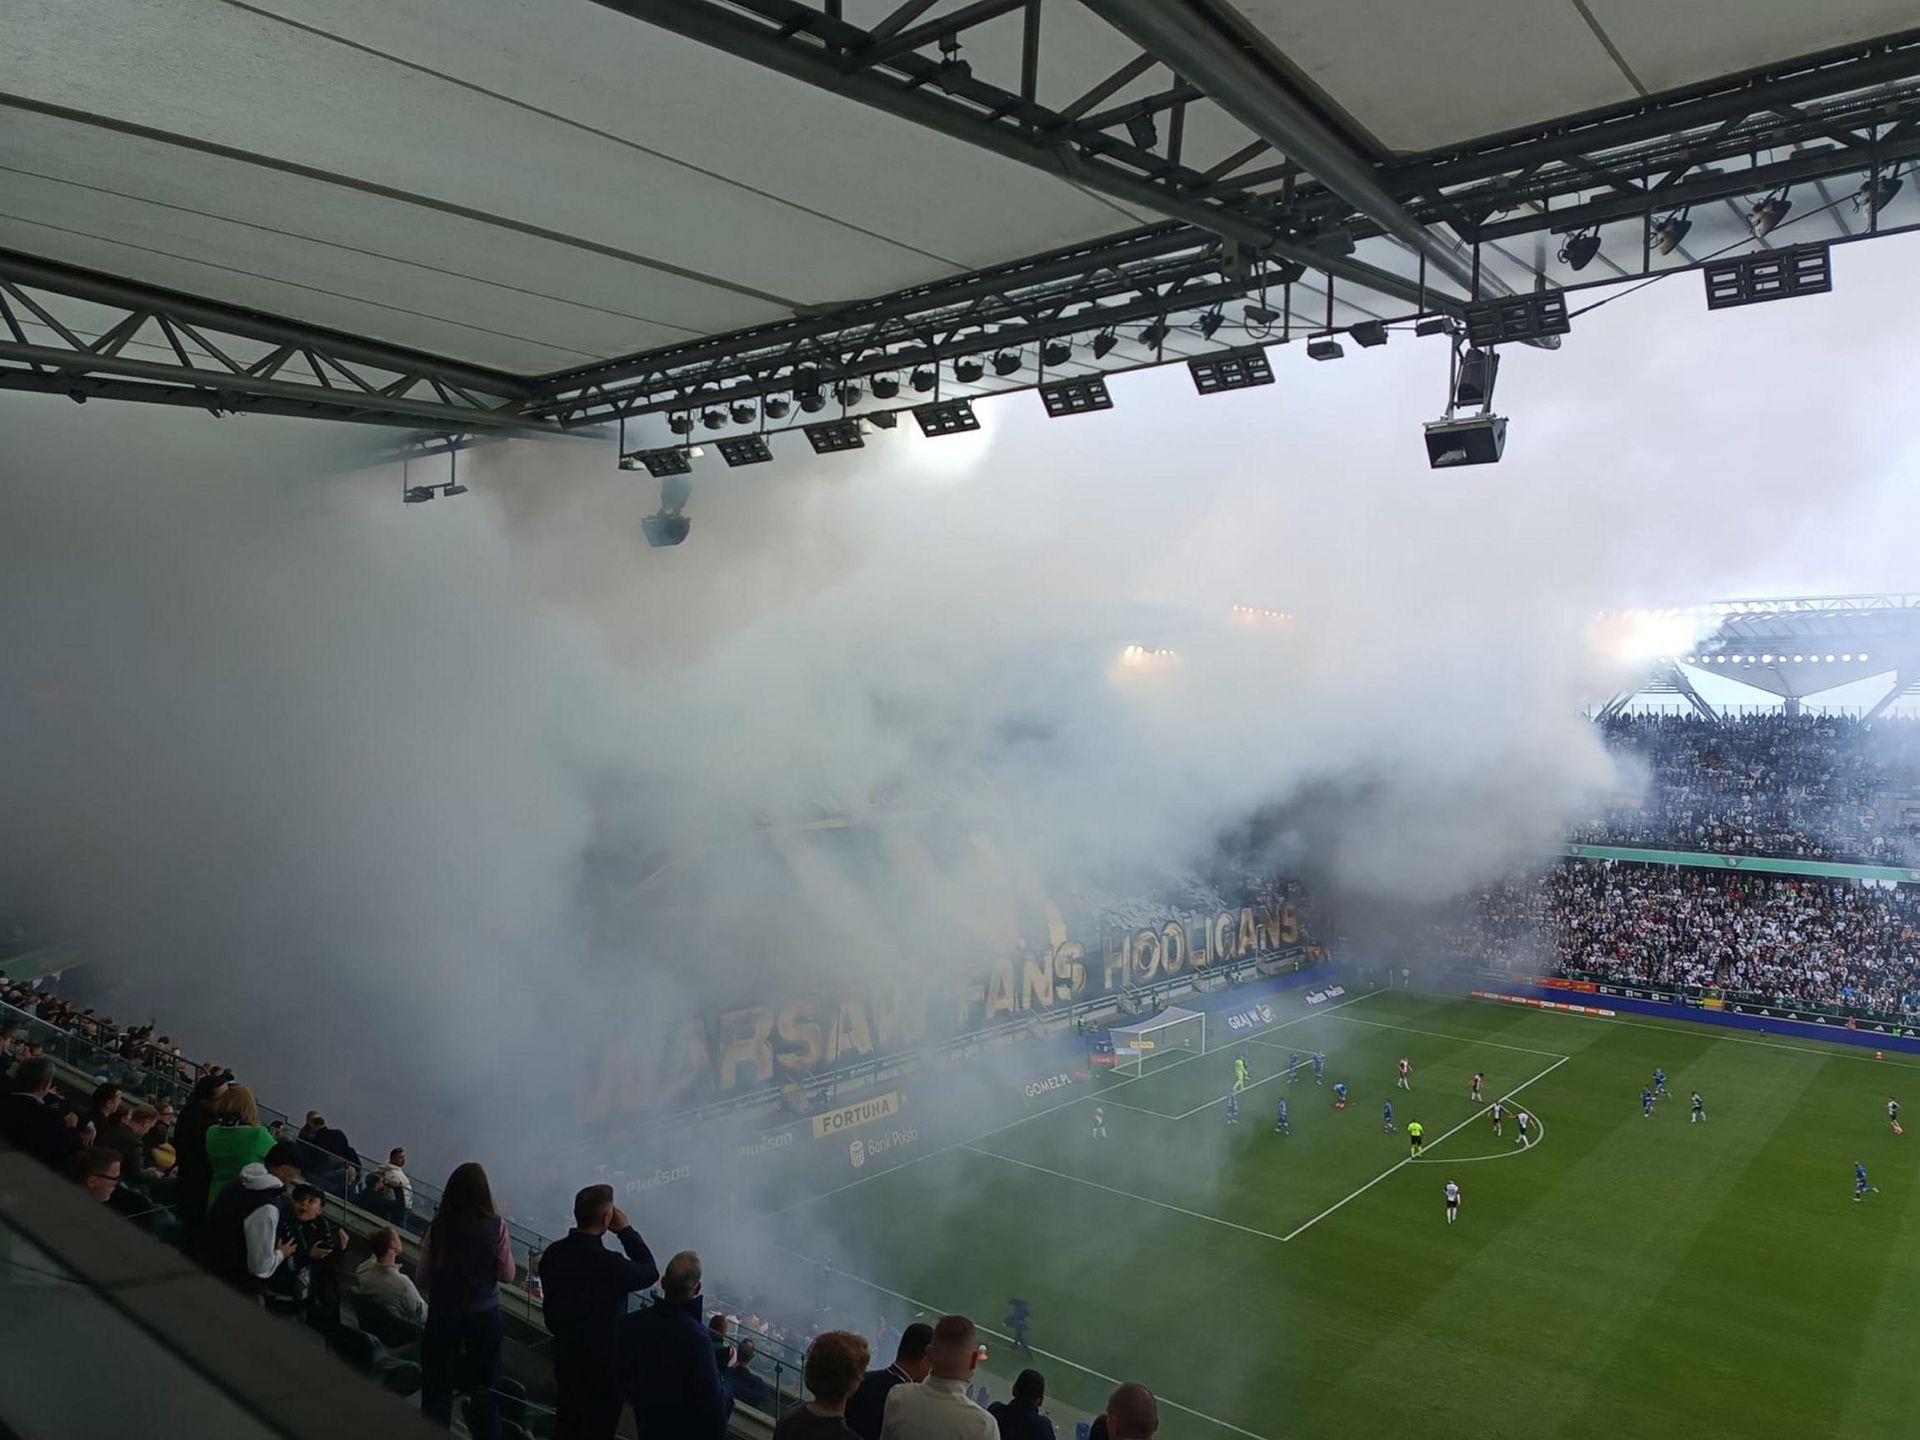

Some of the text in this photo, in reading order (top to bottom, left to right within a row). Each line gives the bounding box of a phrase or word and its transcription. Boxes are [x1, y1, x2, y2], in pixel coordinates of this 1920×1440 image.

[1102, 902, 1300, 989] HOOLIGANS
[1025, 1073, 1072, 1098] GOMEZ.PL
[822, 1099, 891, 1133] FORTUNA
[868, 1134, 891, 1156] Bank
